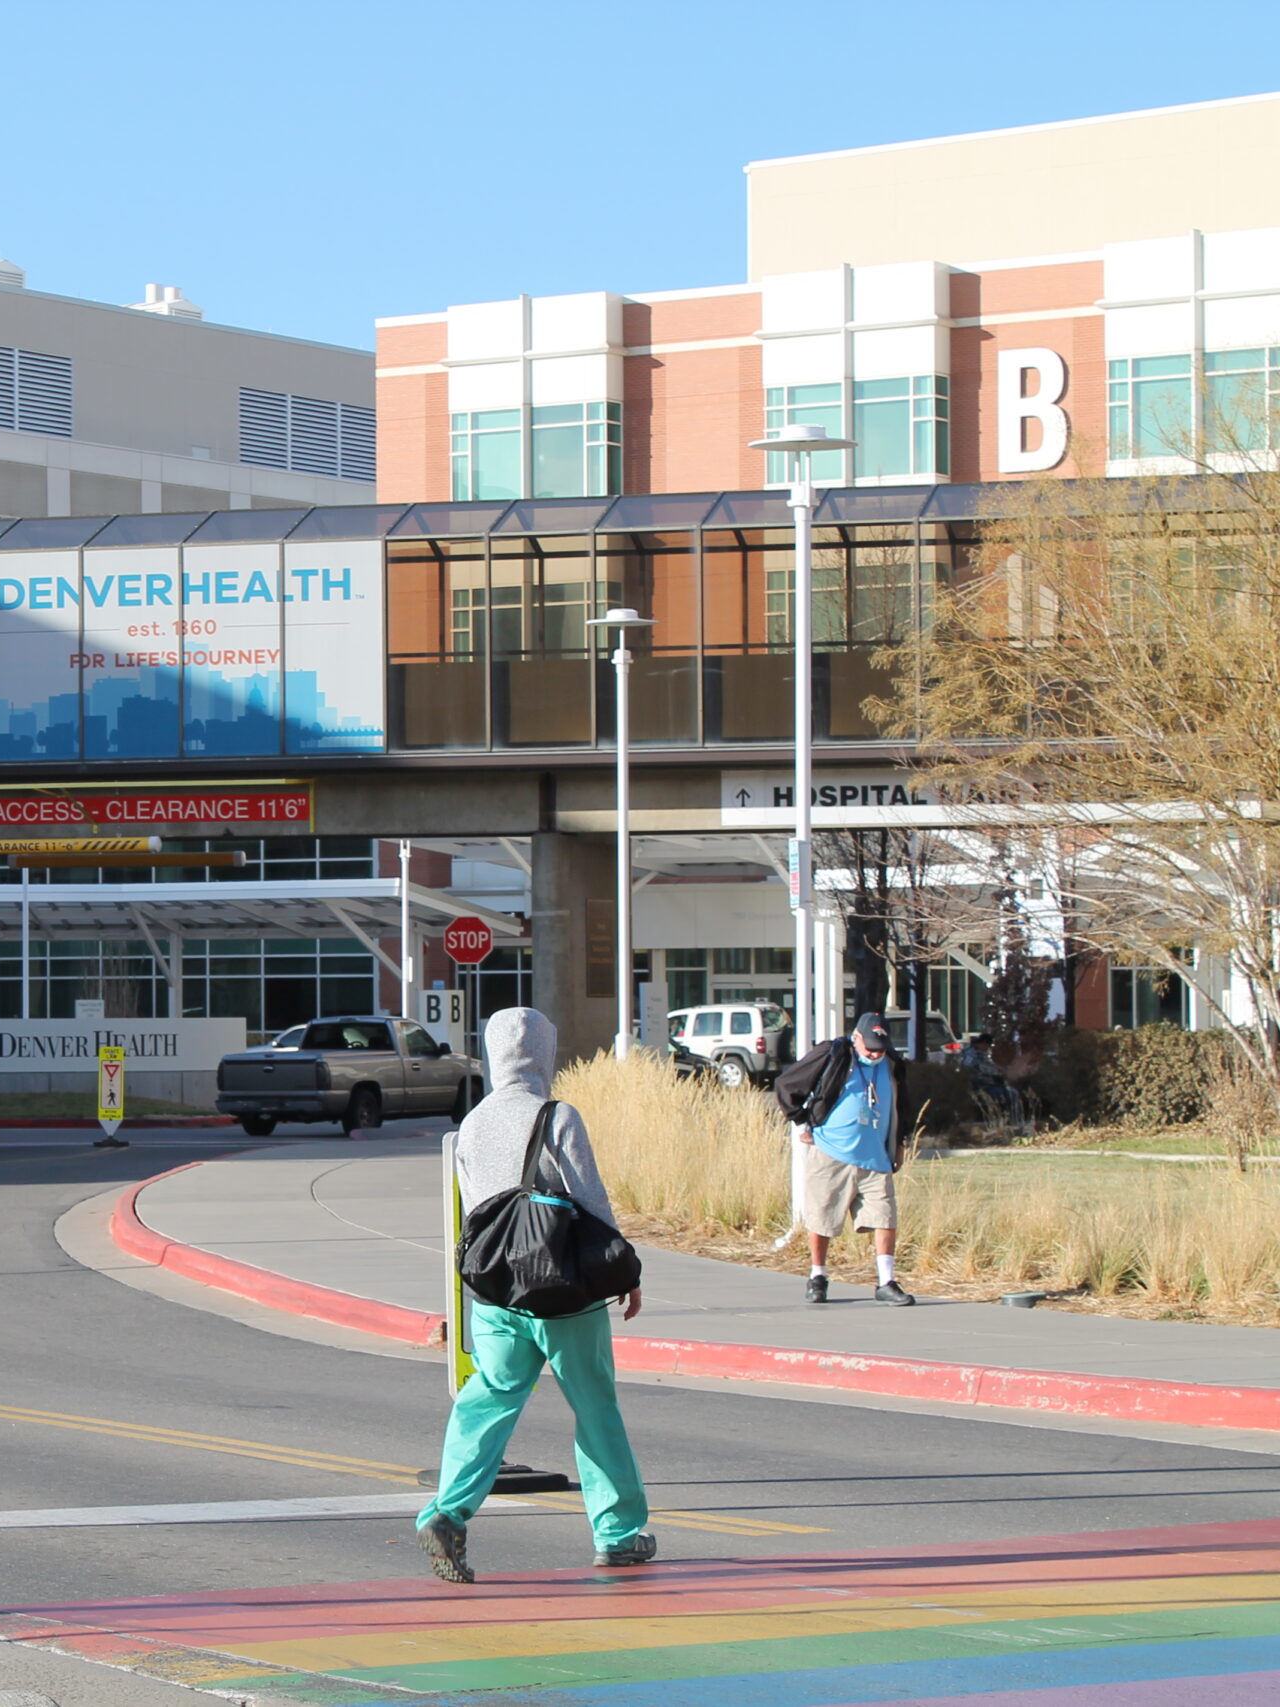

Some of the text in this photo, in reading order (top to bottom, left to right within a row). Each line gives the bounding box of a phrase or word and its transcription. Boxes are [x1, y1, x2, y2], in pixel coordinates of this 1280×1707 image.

[998, 347, 1068, 473] B
[182, 568, 351, 605] HEALTH
[127, 621, 166, 637] est.
[70, 649, 282, 669] FOR LIFE'S JOURNEY
[106, 799, 249, 820] CLEARANCE
[447, 931, 489, 949] STOP
[427, 994, 441, 1023] B
[451, 994, 460, 1023] B
[94, 1030, 178, 1057] HEALTH
